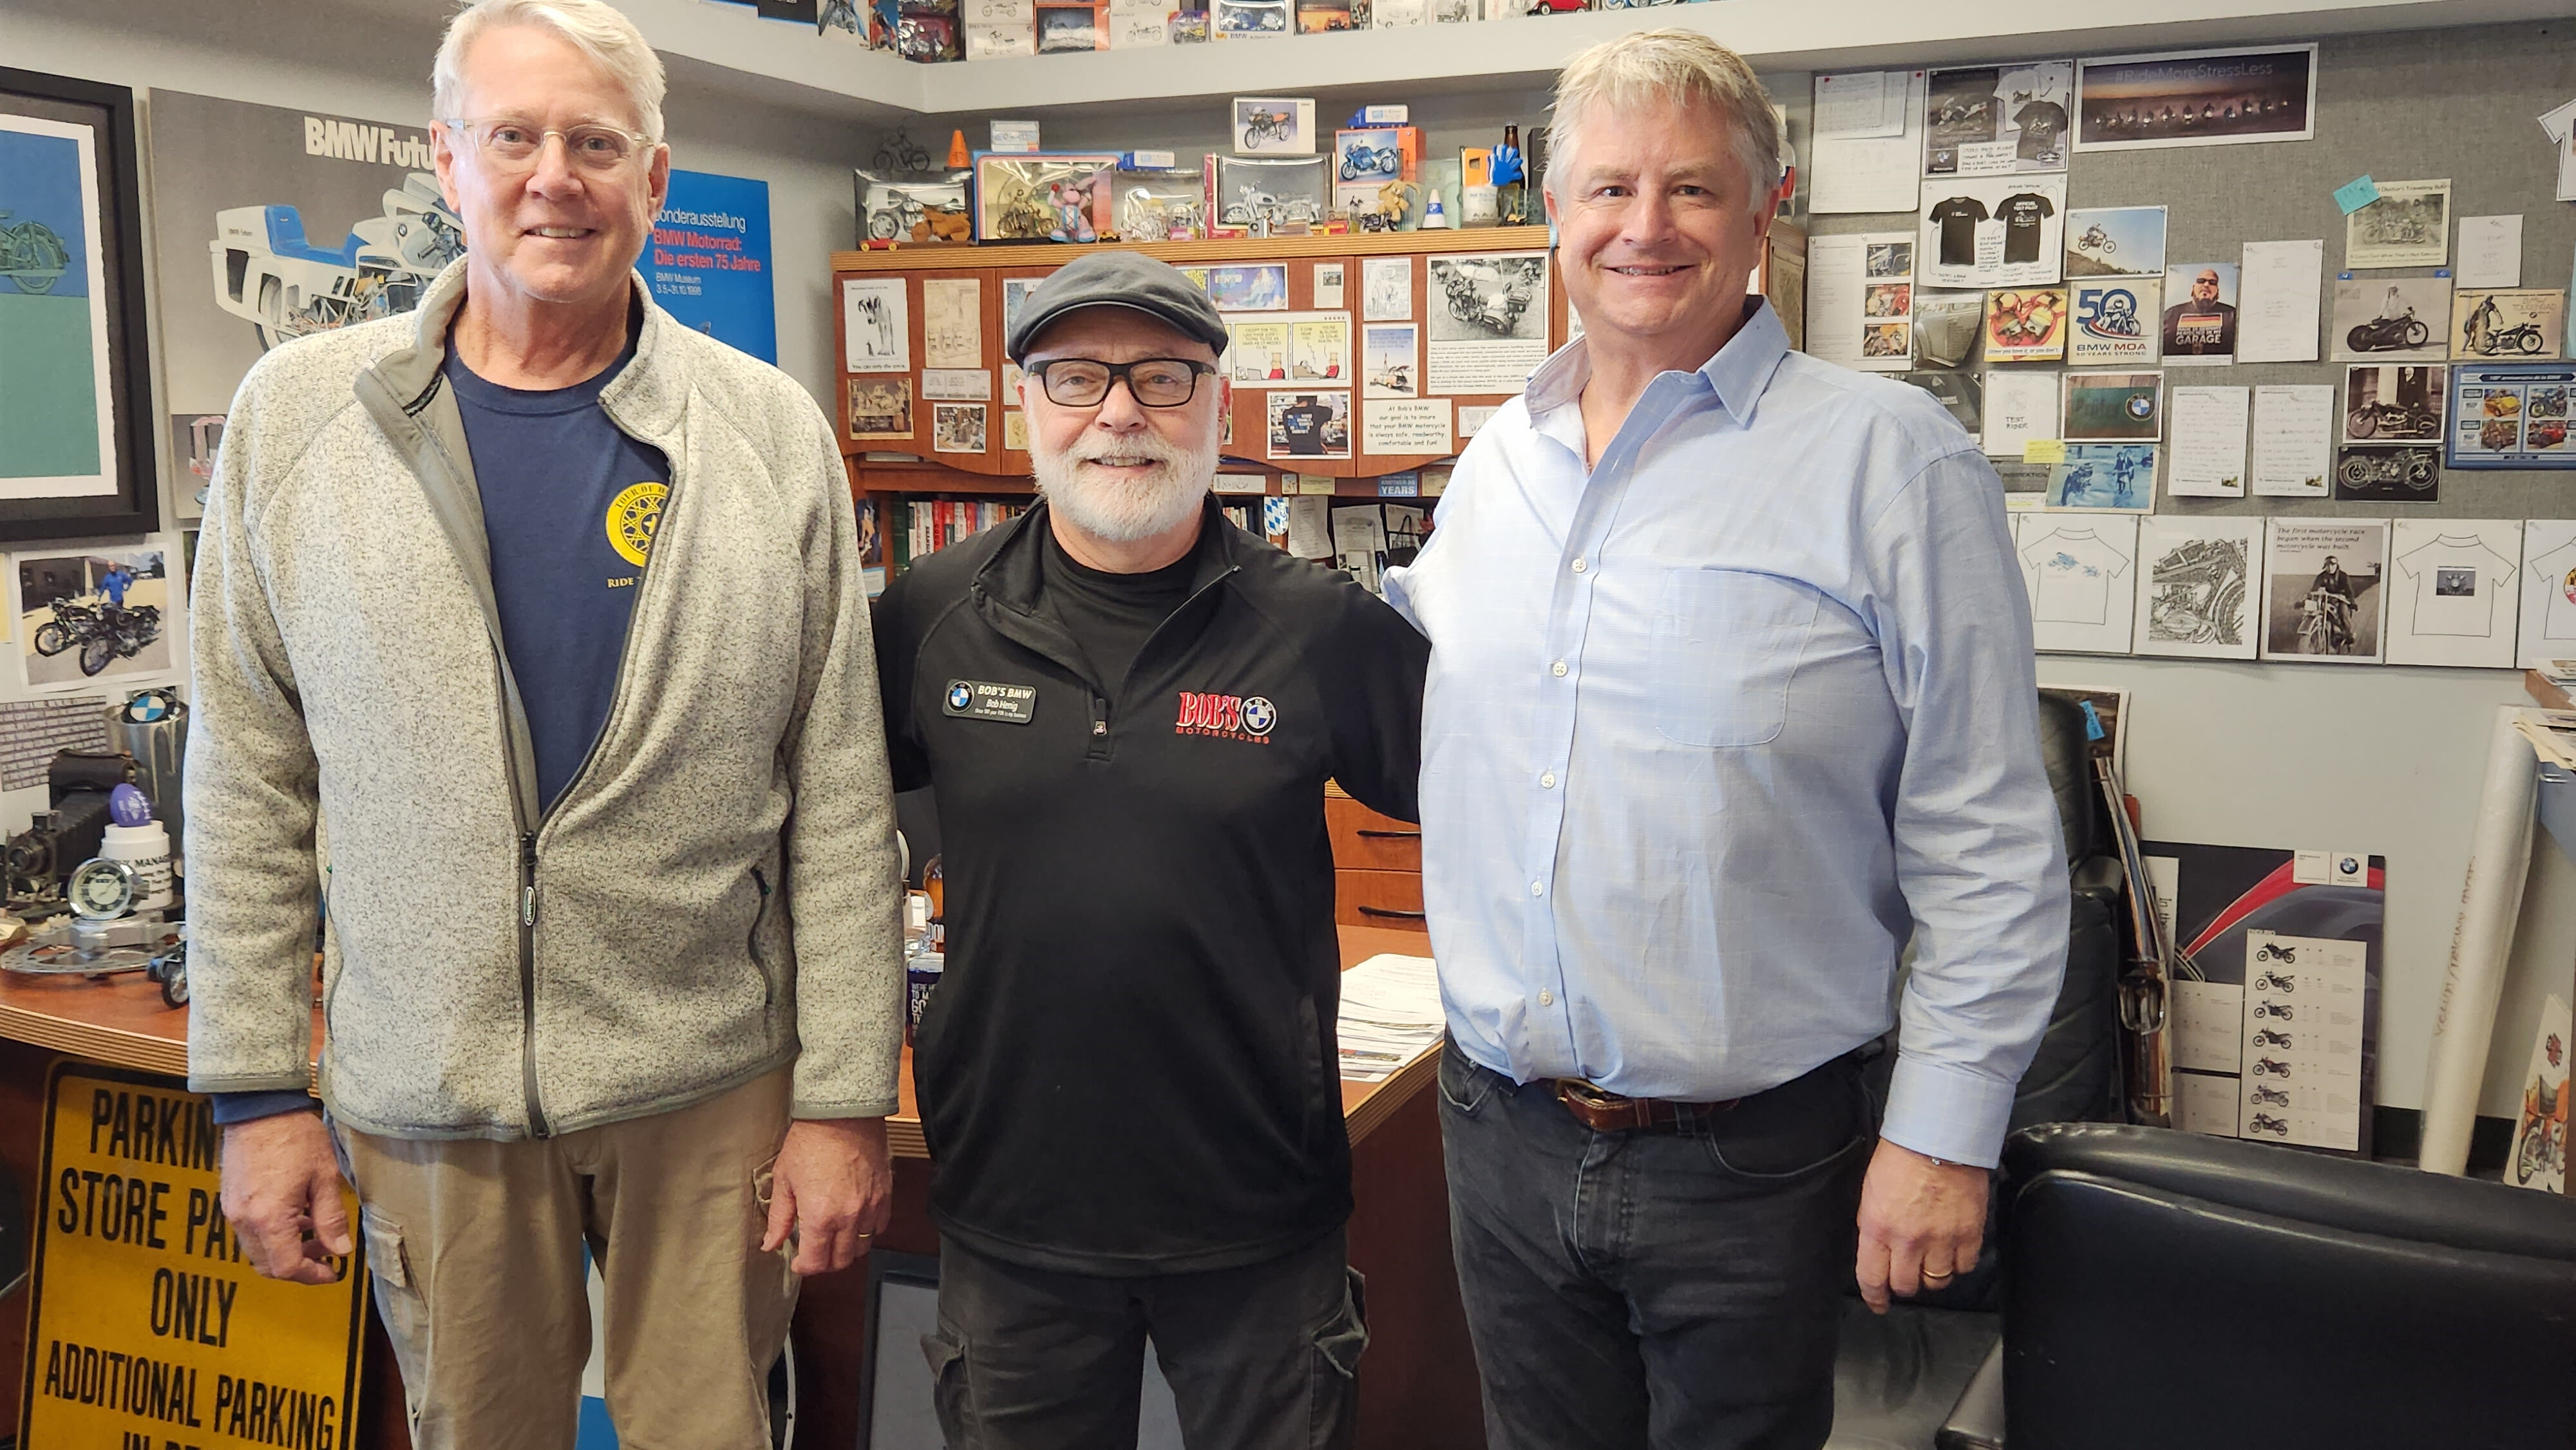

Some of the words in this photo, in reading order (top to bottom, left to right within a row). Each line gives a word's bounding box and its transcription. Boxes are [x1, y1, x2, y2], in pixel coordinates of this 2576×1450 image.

[304, 116, 379, 163] BMW
[380, 128, 435, 170] Futu
[654, 228, 685, 246] BMW
[687, 231, 742, 251] Motorrad:
[654, 249, 674, 265] Die
[677, 253, 713, 268] ersten
[715, 254, 728, 269] 75
[730, 255, 761, 272] Jahre
[656, 272, 674, 282] BMW
[675, 274, 701, 284] Museum
[2176, 334, 2221, 346] GARAGE
[616, 489, 639, 509] TOUR
[1381, 486, 1415, 494] YEARS
[607, 577, 634, 588] RIDE
[978, 684, 1006, 697] BOB'S
[1007, 688, 1032, 699] BMW
[986, 699, 999, 708] Bob
[1176, 692, 1242, 731] BOB'S
[1176, 727, 1270, 744] MOTORCYCLES
[90, 1089, 220, 1172] PARKIN
[58, 1167, 170, 1249] STORE
[150, 1268, 237, 1348] ONLY
[44, 1340, 201, 1428] ADDITIONAL
[214, 1374, 335, 1450] PARKING
